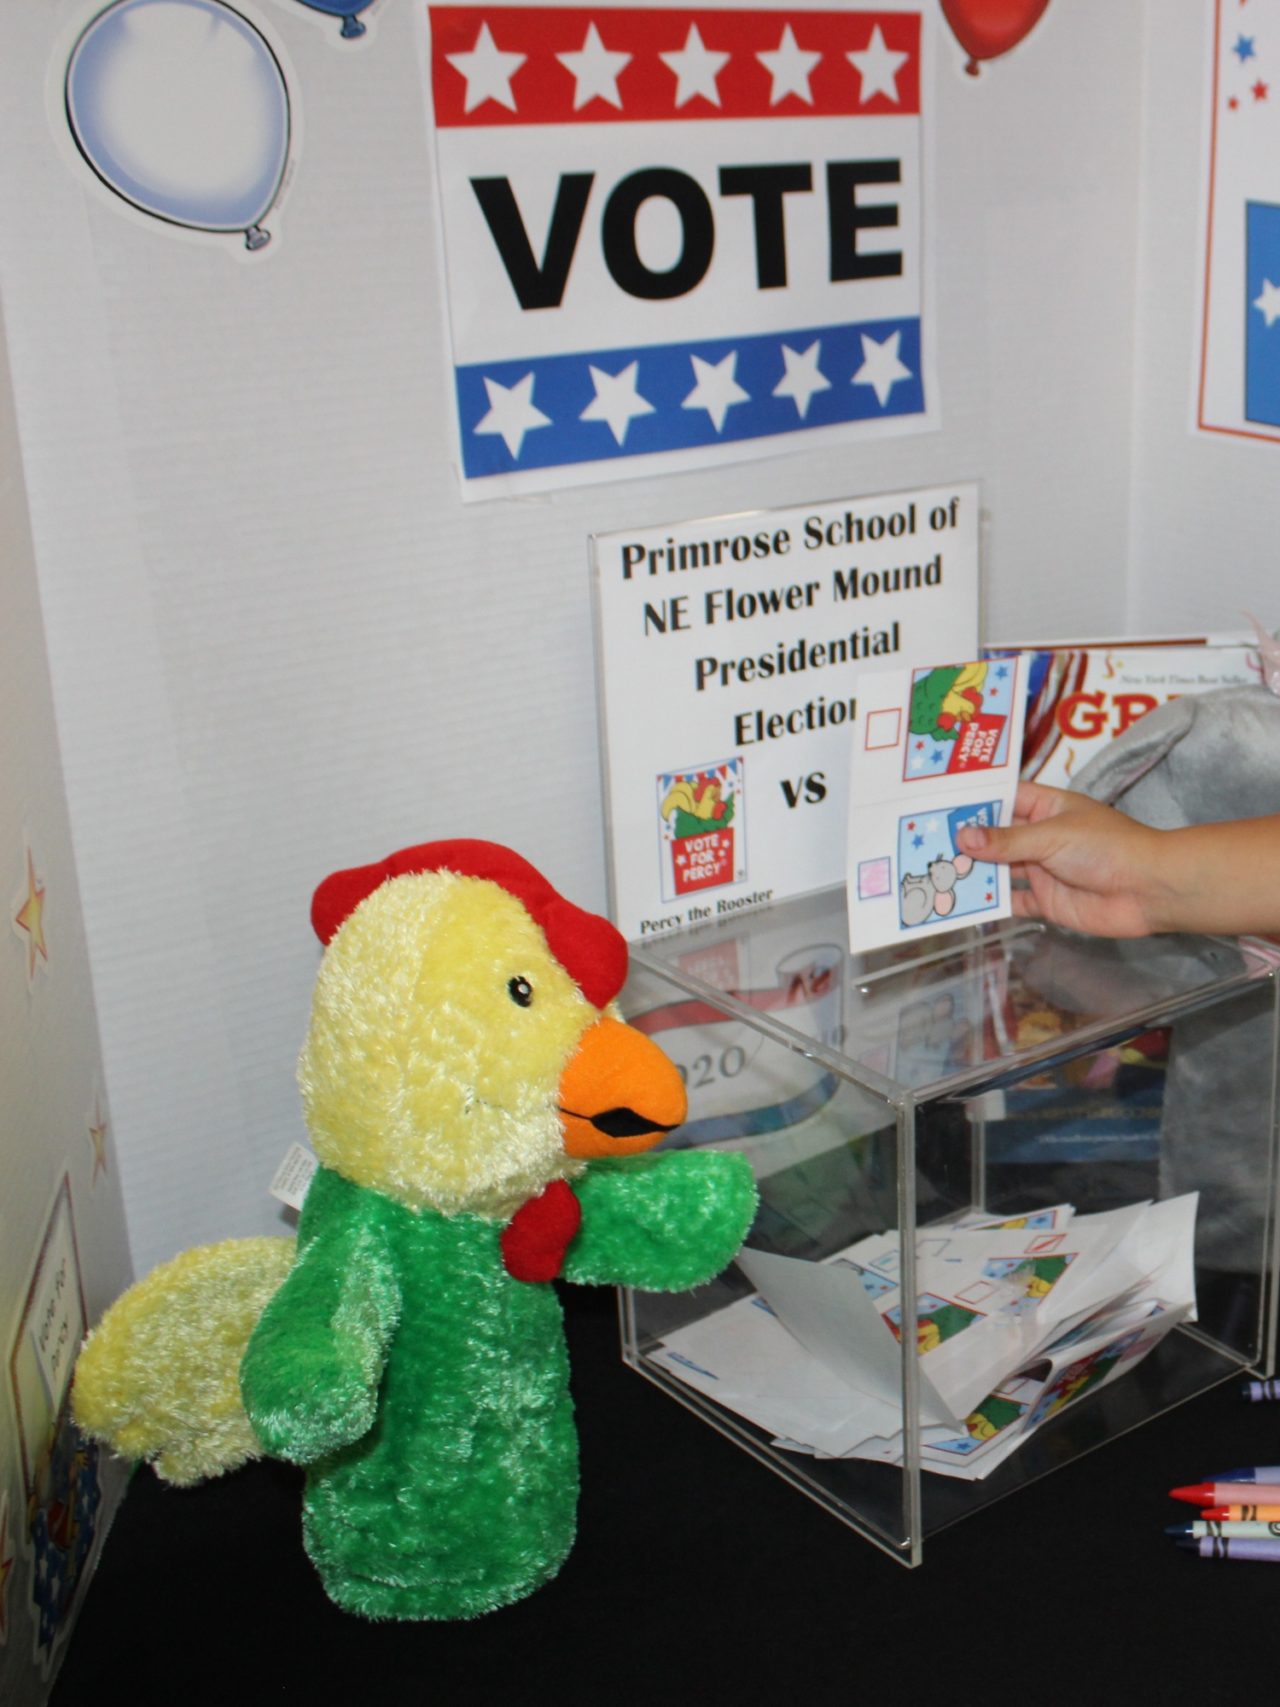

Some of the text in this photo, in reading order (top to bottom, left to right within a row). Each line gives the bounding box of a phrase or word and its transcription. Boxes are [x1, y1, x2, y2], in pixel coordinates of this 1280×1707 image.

[469, 158, 903, 311] VOTE
[621, 496, 961, 580] Primrose School of
[643, 554, 943, 636] NE Flower Mound
[694, 622, 901, 691] Presidential
[971, 730, 988, 757] FOR
[978, 729, 999, 763] VOTE
[684, 833, 720, 853] VOTE
[690, 849, 715, 866] FOR
[640, 913, 683, 935] Percy
[687, 903, 712, 921] the
[717, 889, 773, 914] Rooster
[676, 1045, 747, 1089] 20
